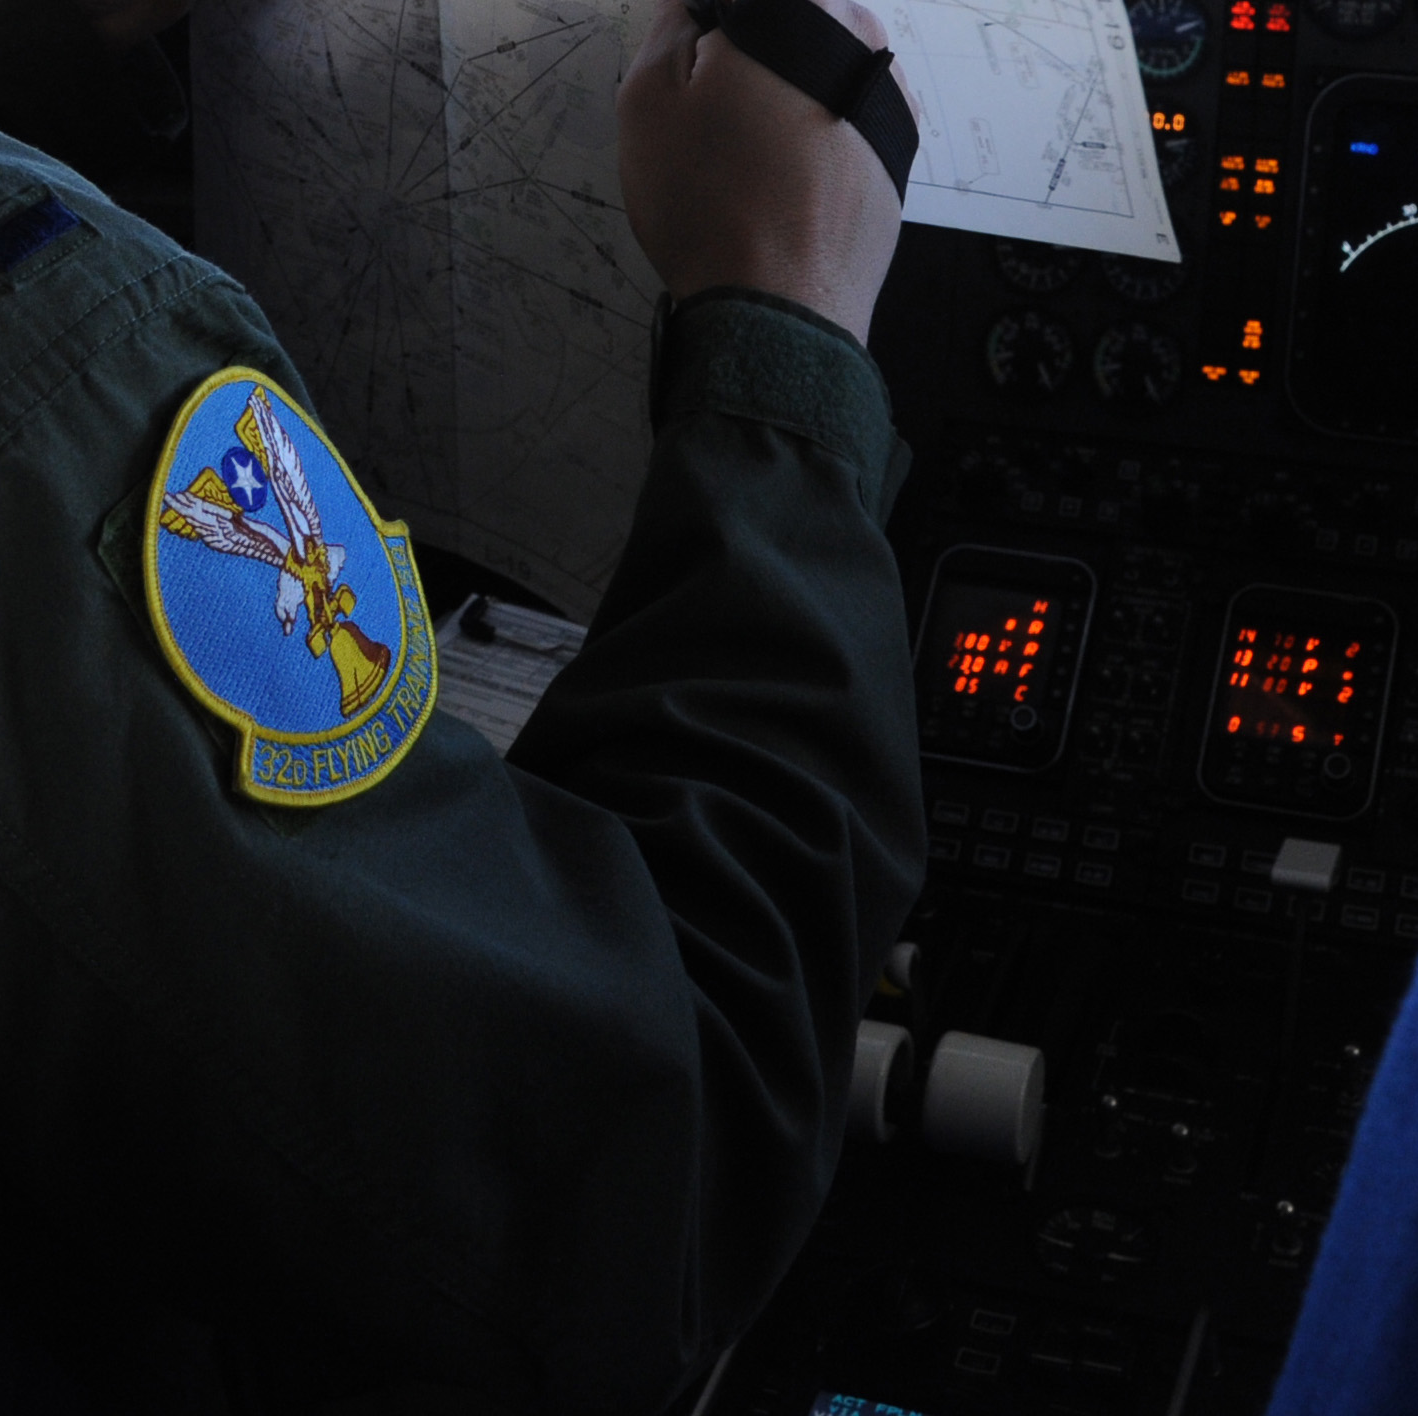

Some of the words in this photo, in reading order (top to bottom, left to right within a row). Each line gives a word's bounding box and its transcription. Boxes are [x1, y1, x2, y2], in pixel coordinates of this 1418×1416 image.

[258, 744, 308, 786] 32D
[312, 720, 393, 784] FLYING
[386, 596, 431, 733] TRAINING
[831, 1392, 868, 1409] ACT
